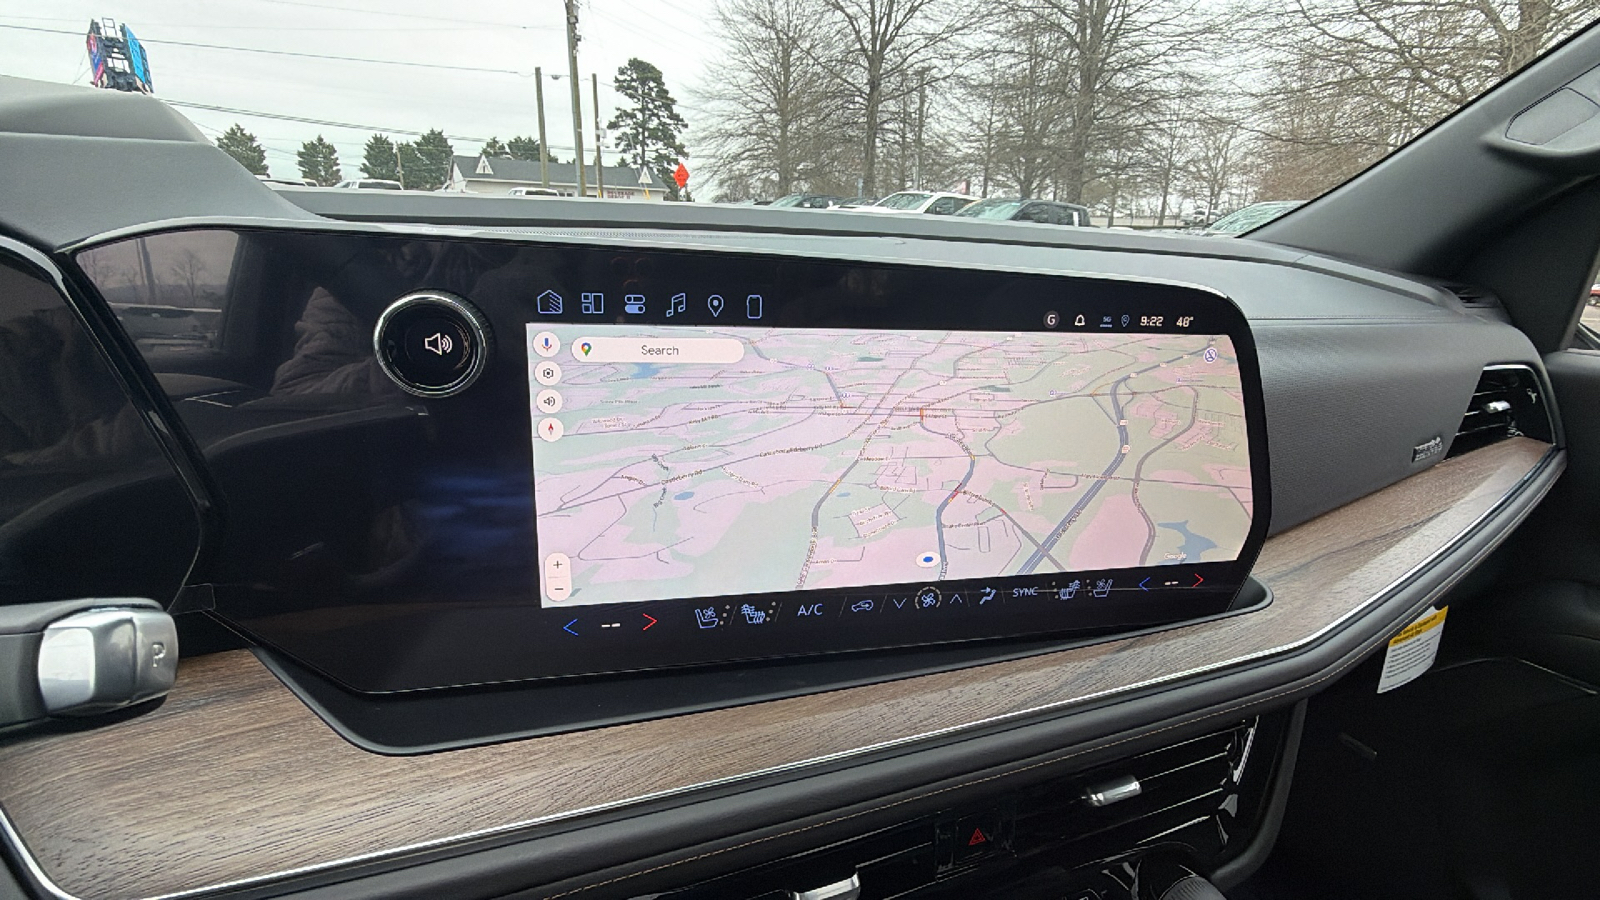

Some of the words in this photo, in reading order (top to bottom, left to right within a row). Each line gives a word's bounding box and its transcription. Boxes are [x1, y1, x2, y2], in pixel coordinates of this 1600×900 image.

[1047, 314, 1056, 325] G
[1139, 315, 1164, 327] 9:22
[1176, 316, 1194, 327] 48°
[641, 344, 680, 356] Search
[1164, 551, 1187, 560] Google
[1012, 587, 1038, 598] SYNC
[797, 603, 823, 617] A/C
[152, 641, 166, 668] P
